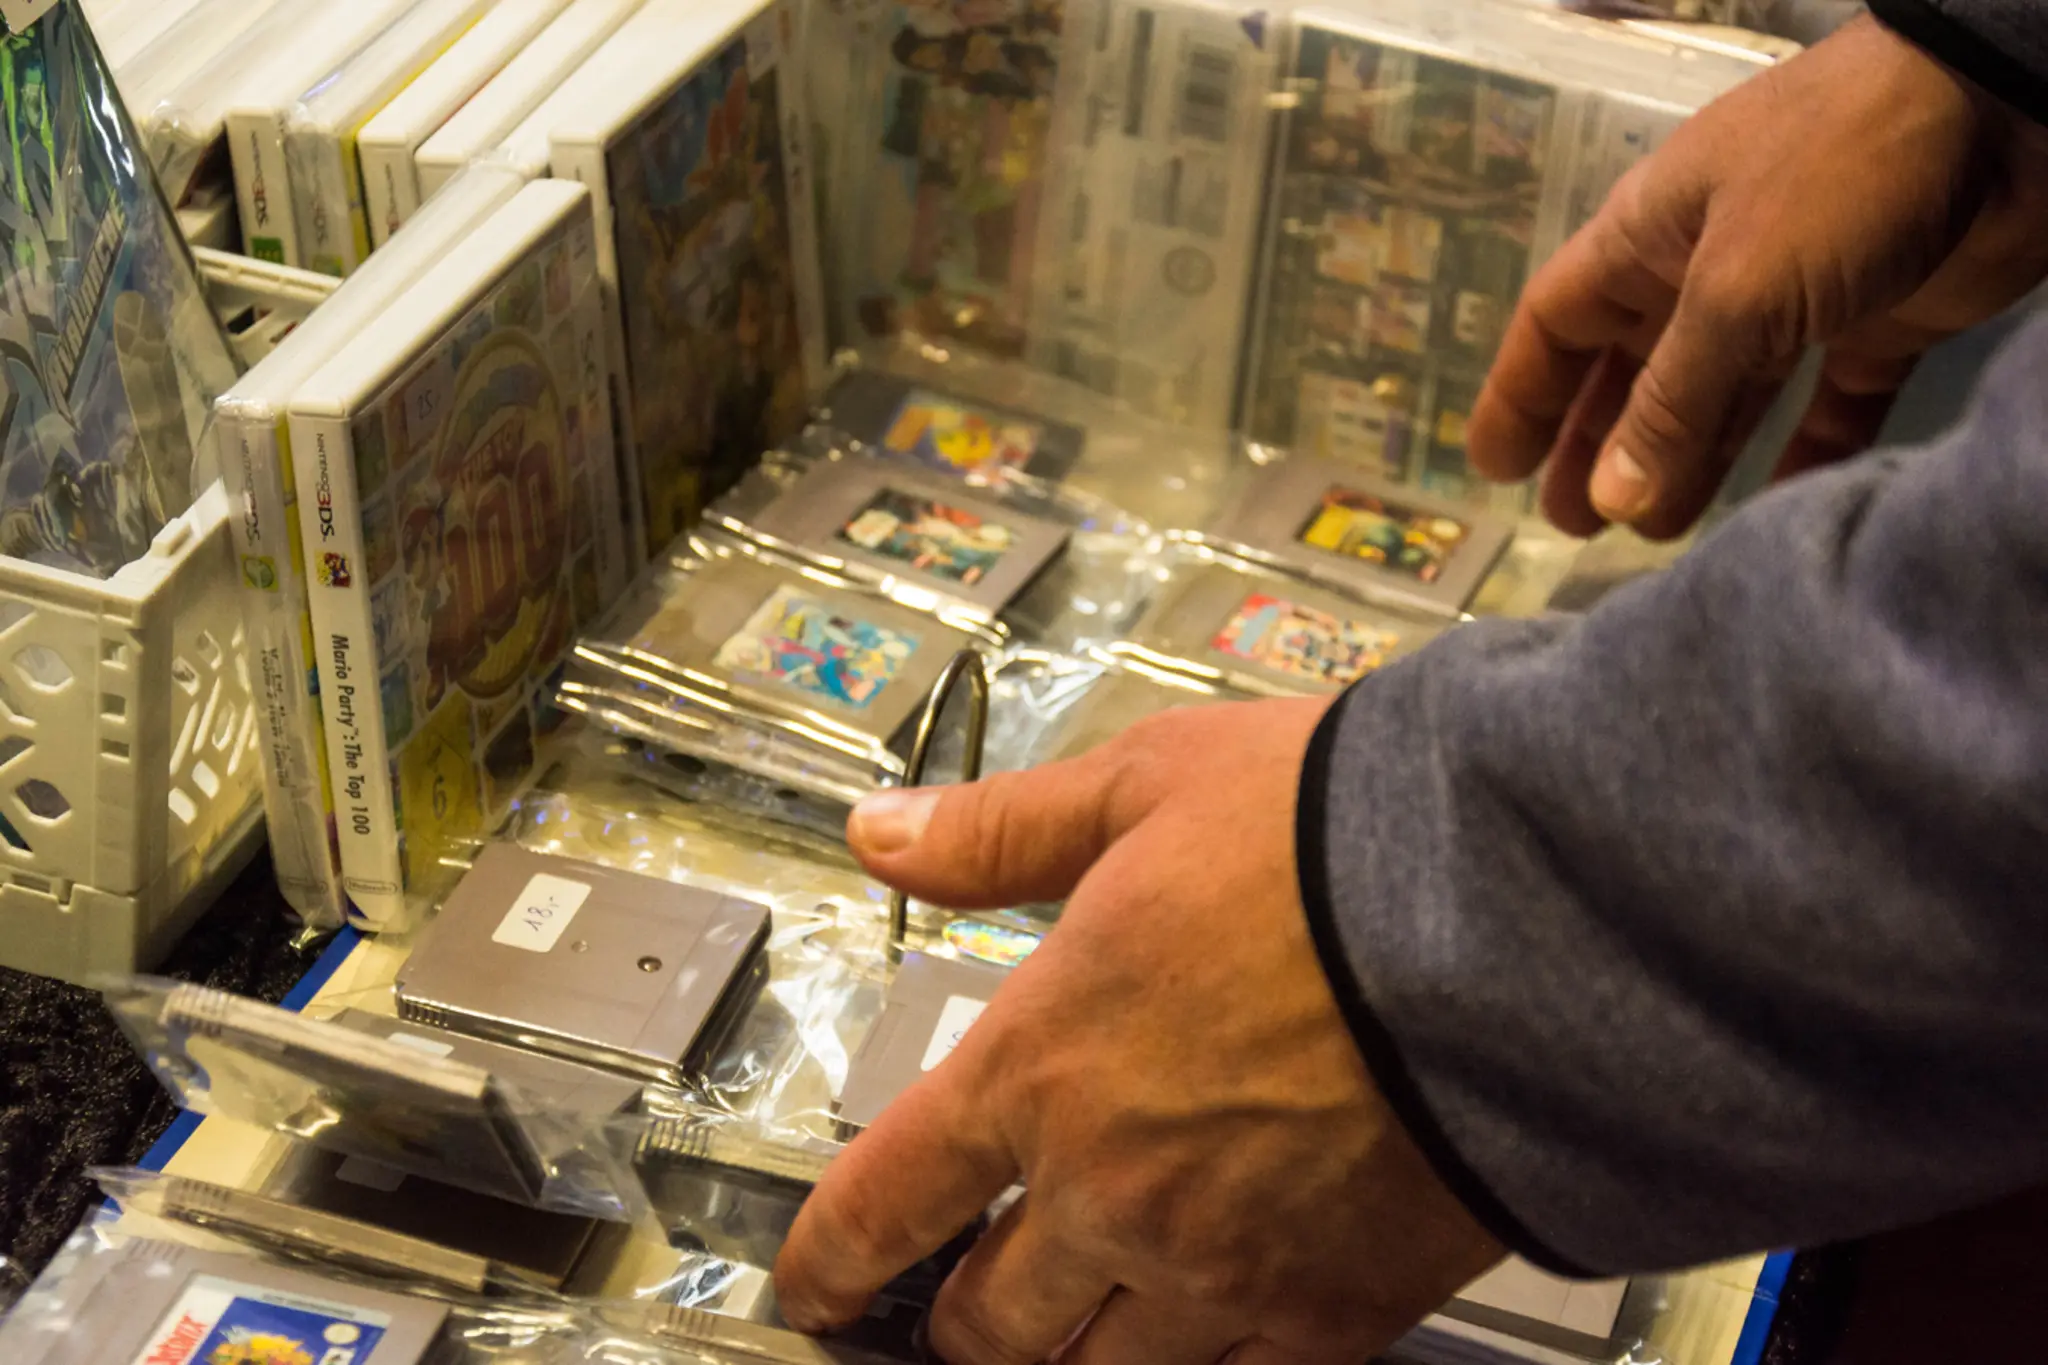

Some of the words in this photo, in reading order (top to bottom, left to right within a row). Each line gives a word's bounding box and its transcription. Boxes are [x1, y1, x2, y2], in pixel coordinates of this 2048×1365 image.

[331, 633, 352, 680] Mario
[343, 743, 363, 770] The
[344, 775, 365, 799] Top
[351, 806, 370, 835] 100
